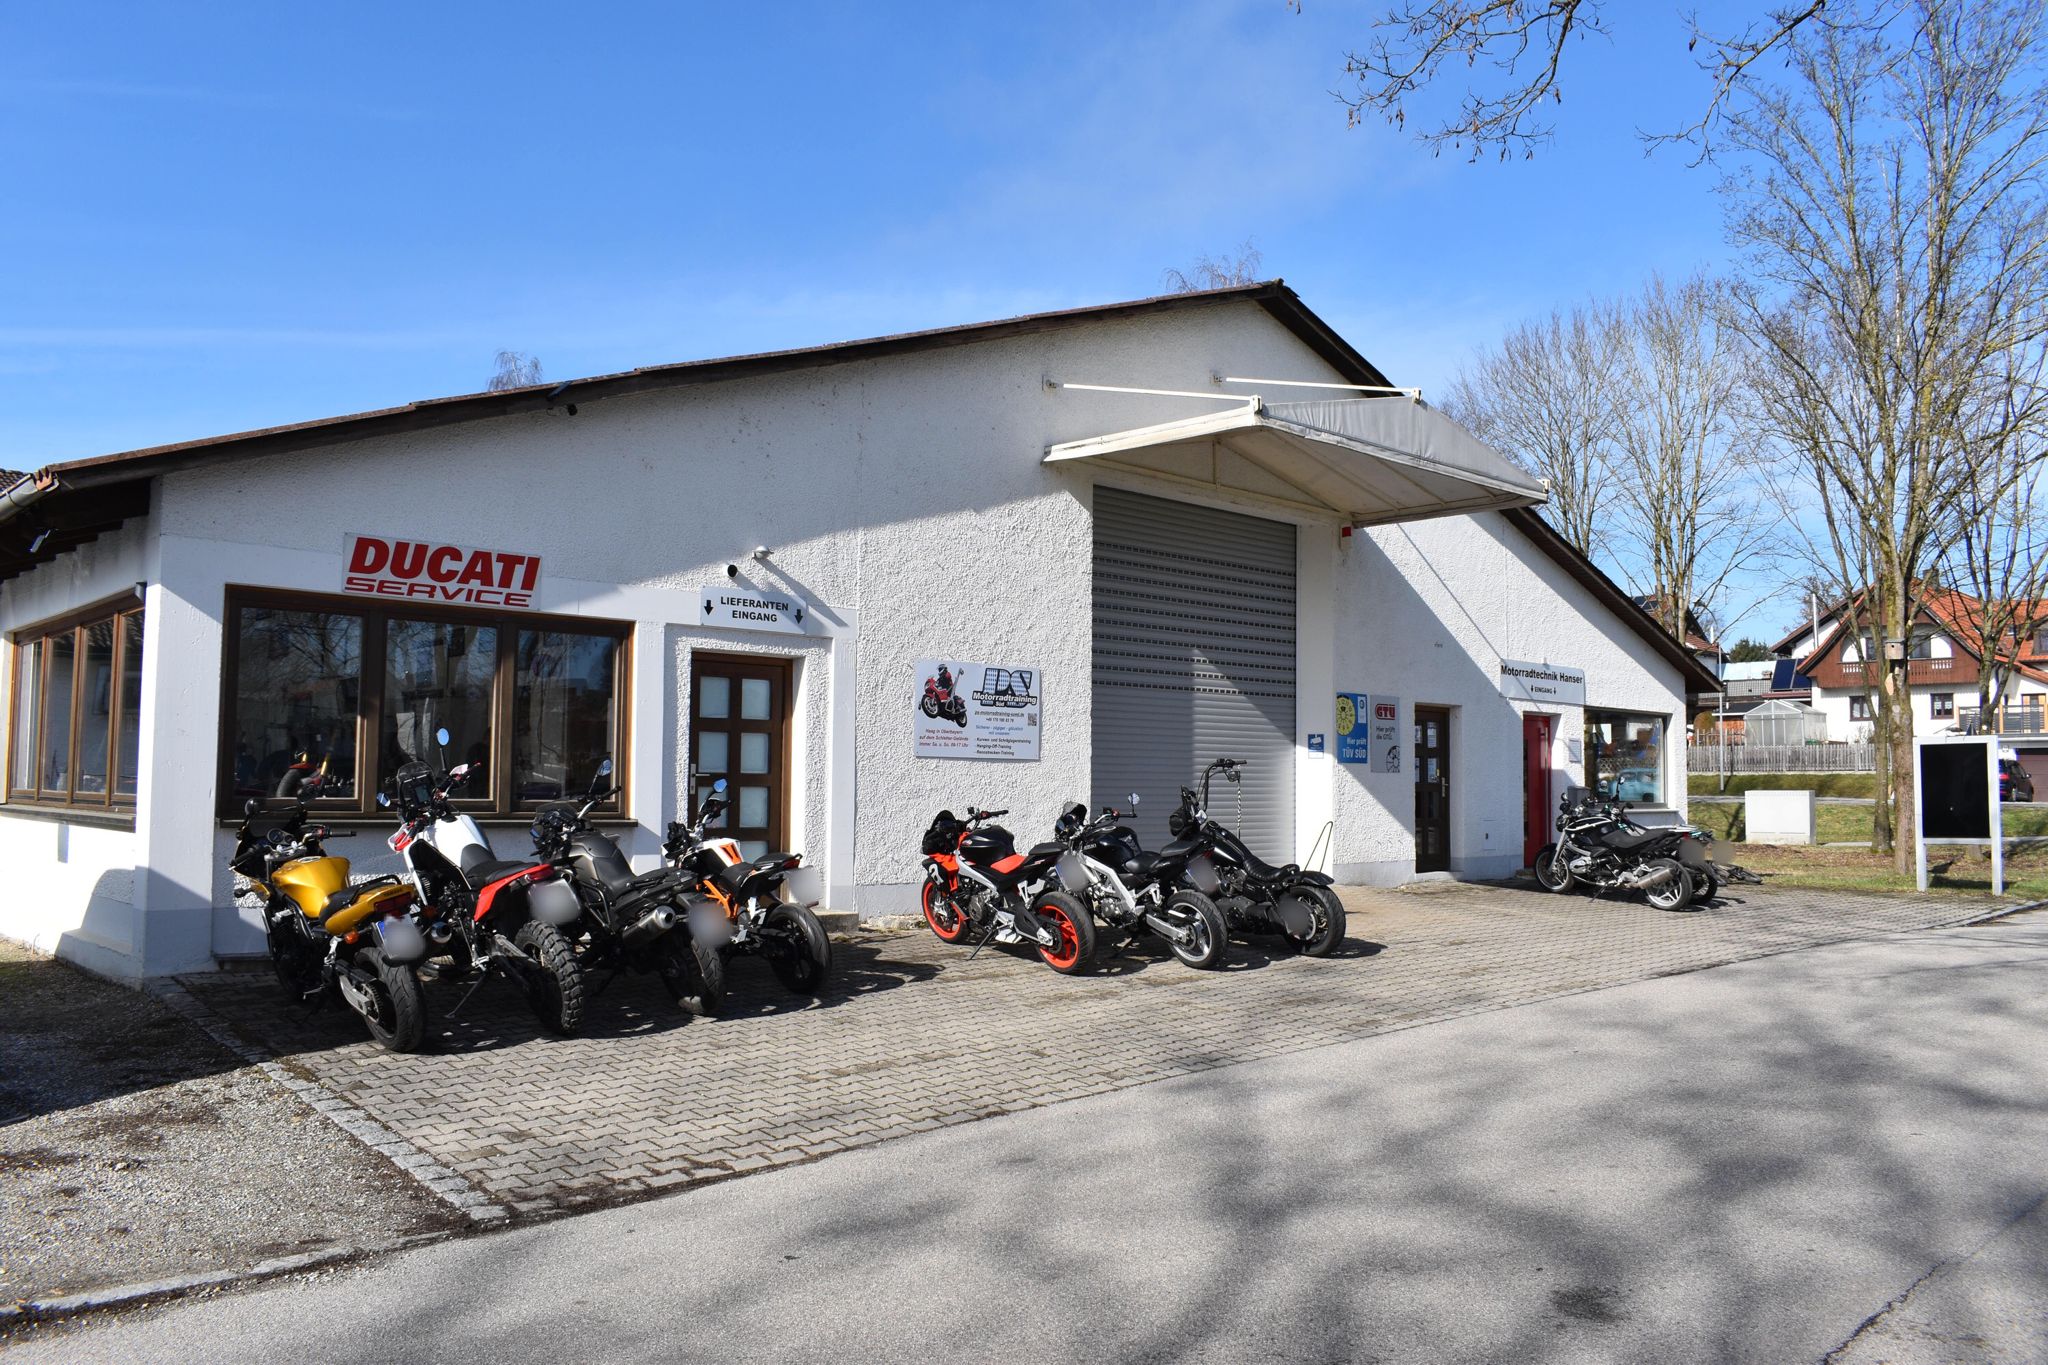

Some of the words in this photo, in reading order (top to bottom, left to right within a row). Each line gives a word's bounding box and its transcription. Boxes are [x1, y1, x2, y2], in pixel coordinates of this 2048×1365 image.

[349, 537, 541, 590] DUCATI
[345, 577, 532, 607] SERVICE
[720, 596, 789, 611] LIEFERANTEN
[732, 610, 778, 623] EINGANG
[1501, 665, 1558, 681] Motorradtechnik
[1559, 673, 1583, 684] Hanser
[1534, 686, 1553, 694] EINGANG
[973, 692, 1037, 705] Motorradtraining
[1343, 747, 1354, 758] TÜV
[1355, 748, 1366, 759] SÜD
